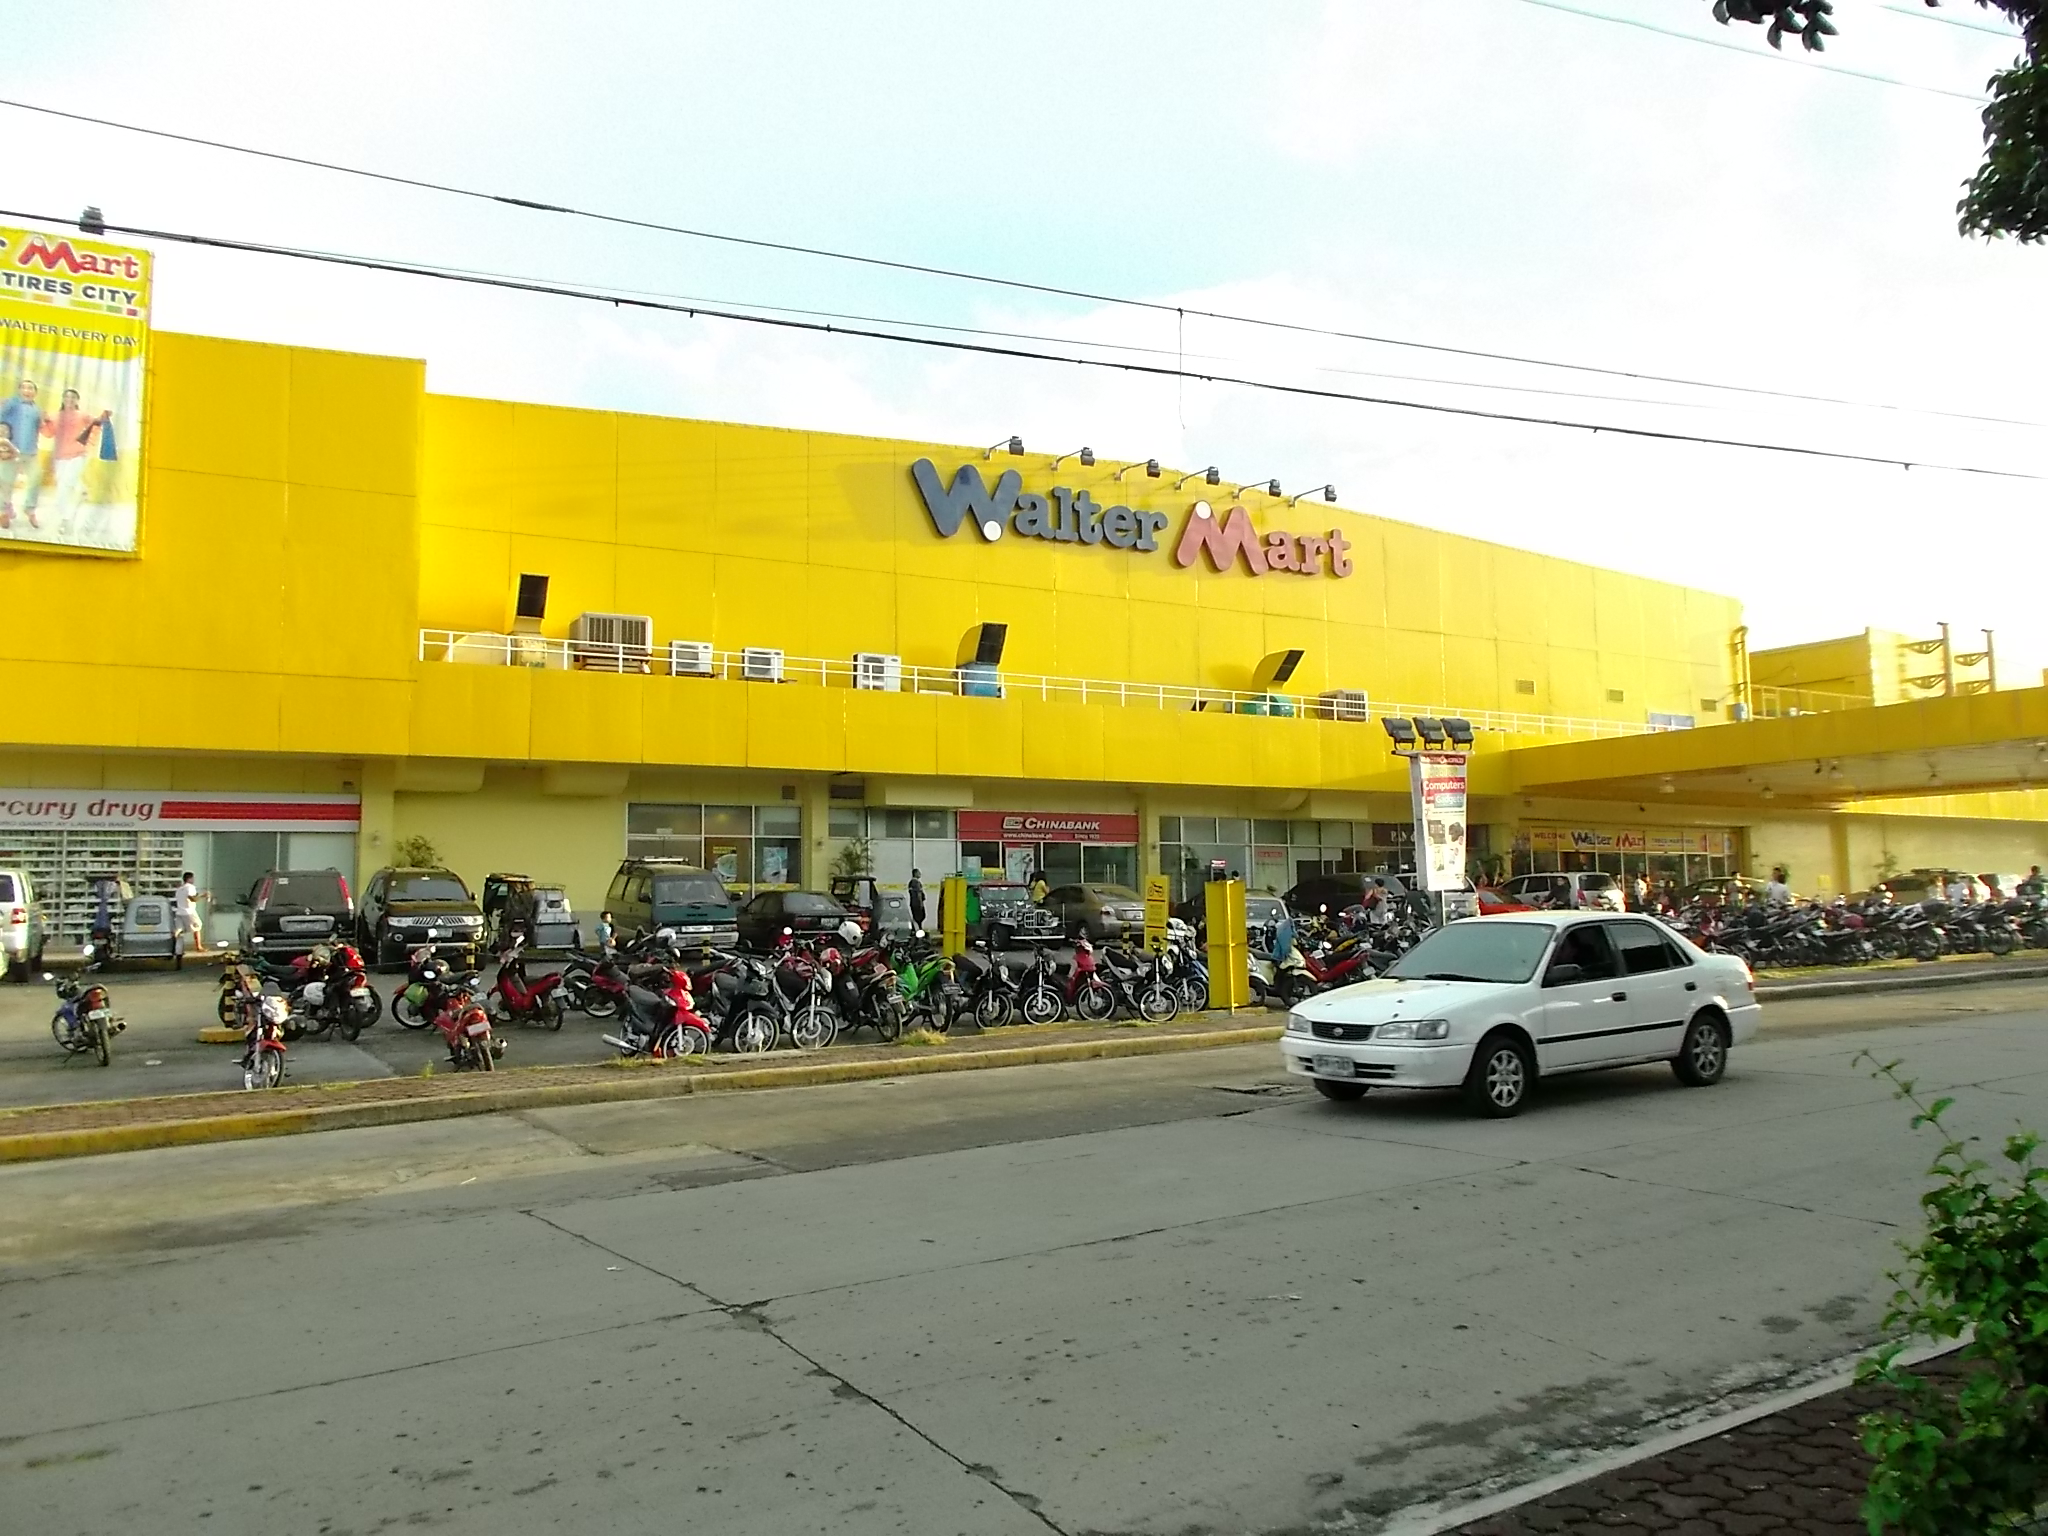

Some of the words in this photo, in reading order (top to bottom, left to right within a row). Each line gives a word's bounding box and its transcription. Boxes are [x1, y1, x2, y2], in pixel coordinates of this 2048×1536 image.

[17, 236, 140, 279] Mart
[81, 285, 138, 305] CITY
[62, 327, 108, 343] EVERY
[113, 335, 140, 347] DAY
[911, 457, 1168, 553] Walter
[1175, 500, 1354, 578] Mart
[1423, 780, 1465, 791] Computers
[87, 799, 154, 821] drug
[1025, 817, 1101, 831] CHINABANK
[1570, 830, 1613, 848] Walter
